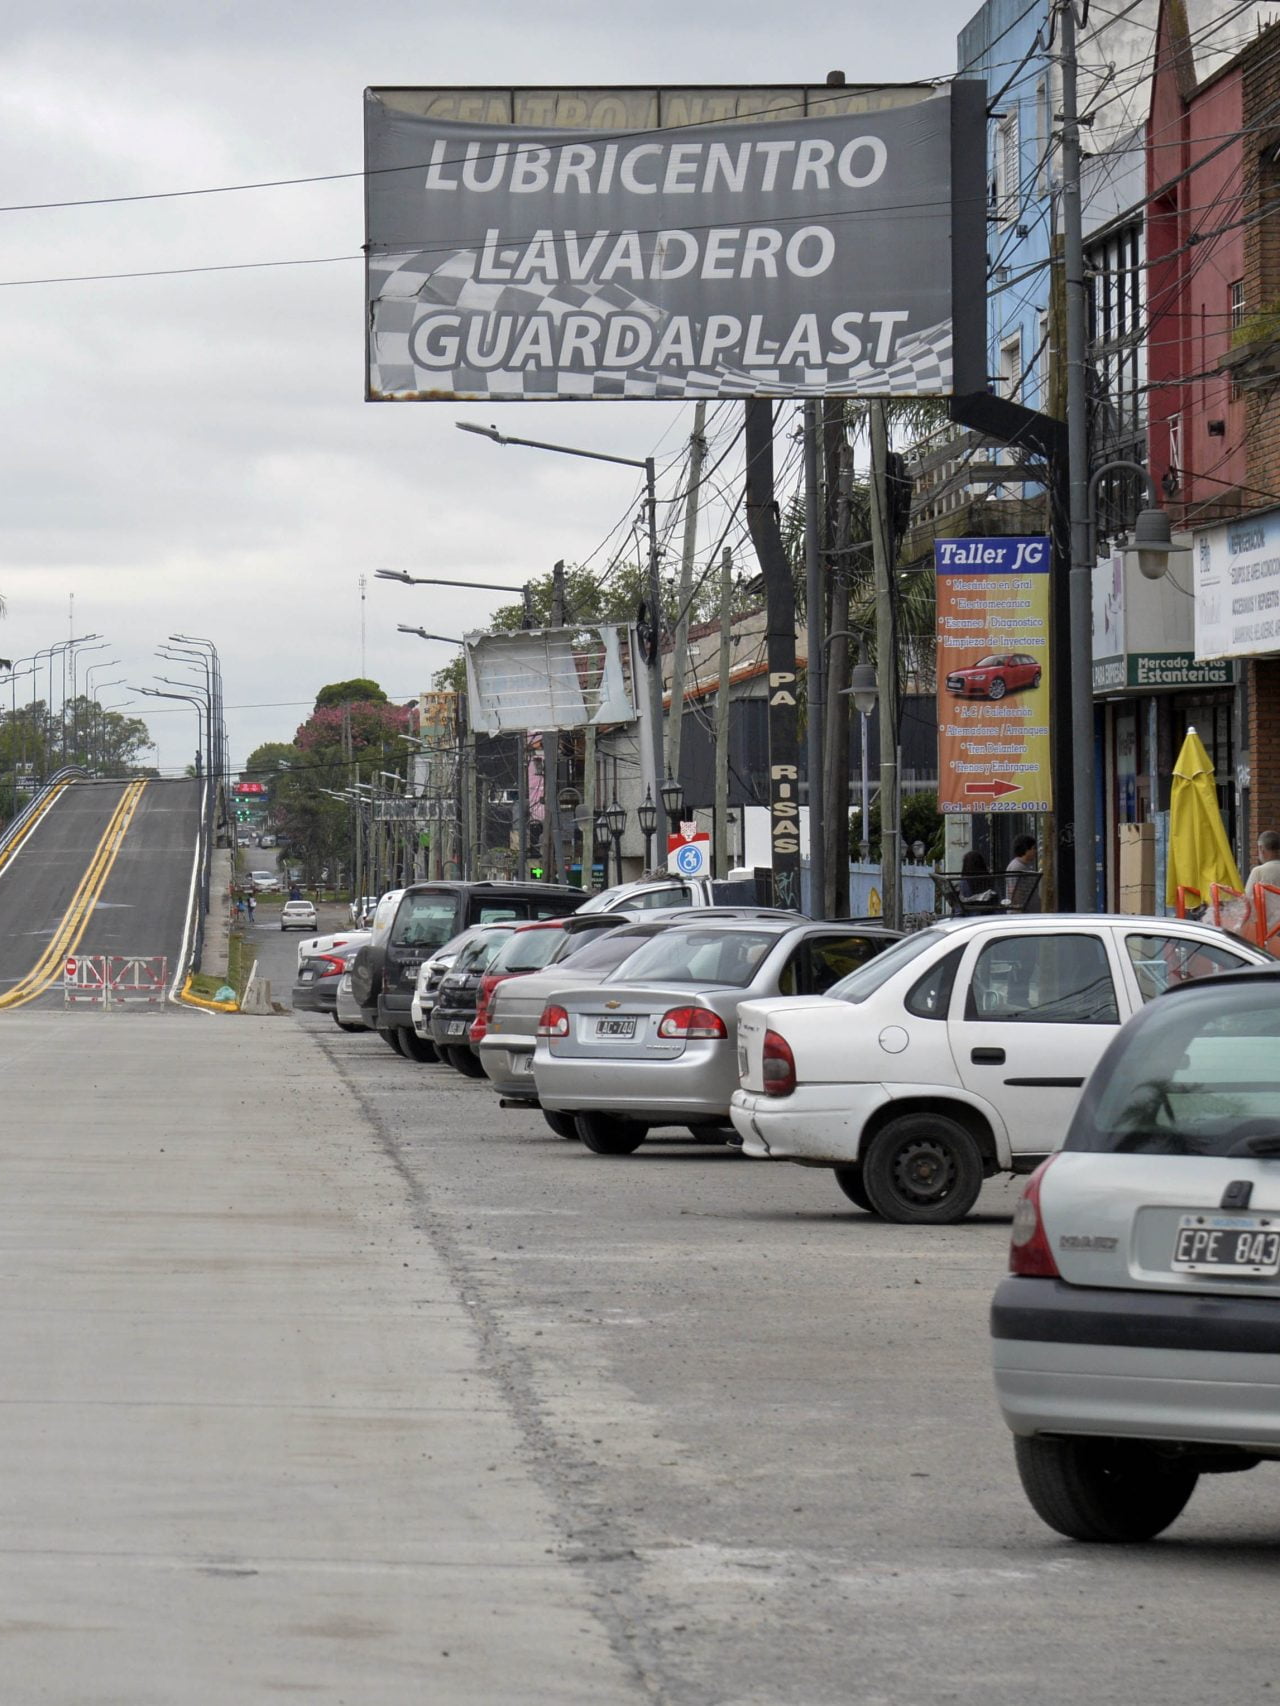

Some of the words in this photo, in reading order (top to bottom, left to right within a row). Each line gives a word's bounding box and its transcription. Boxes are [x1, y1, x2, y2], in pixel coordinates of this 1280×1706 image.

[424, 135, 888, 195] LUBRICENTRO
[477, 225, 837, 279] LAVADERO
[413, 310, 910, 367] GUARDAPLAST
[940, 544, 1007, 564] Taller
[1011, 543, 1043, 569] JG
[986, 635, 998, 647] de
[1138, 657, 1188, 669] Mercado
[1138, 667, 1227, 683] Estanterias
[1177, 1229, 1223, 1262] EPE
[1234, 1233, 1280, 1264] 843
